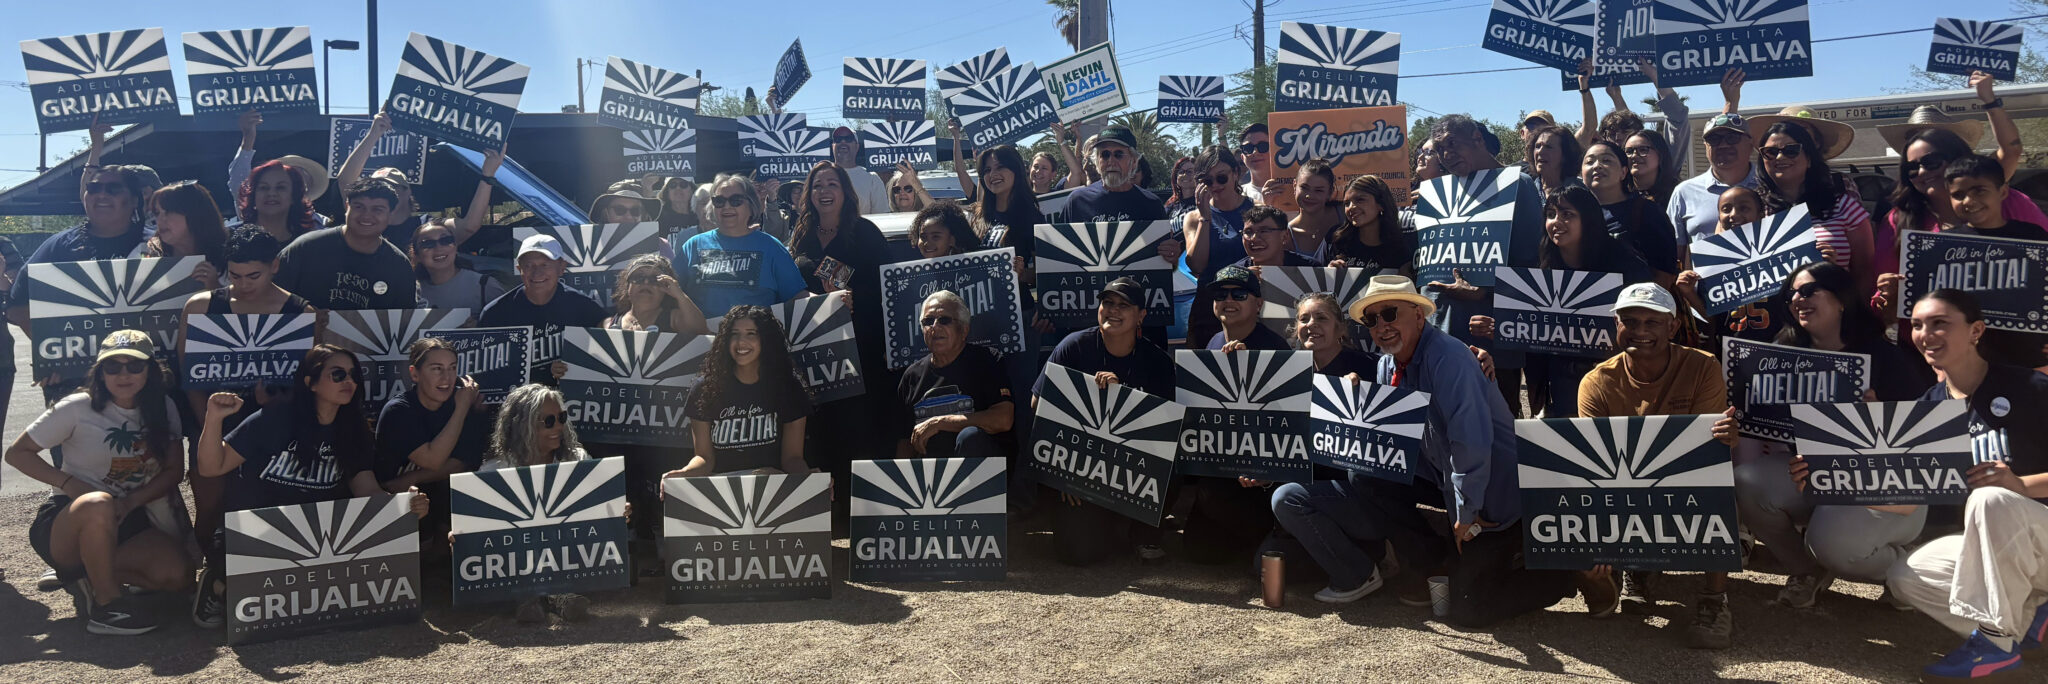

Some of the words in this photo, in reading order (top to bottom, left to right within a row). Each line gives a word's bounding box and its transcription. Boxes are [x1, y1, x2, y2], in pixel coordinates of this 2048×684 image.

[1508, 17, 1577, 42] ADELITA
[1682, 27, 1784, 45] ADELITA
[1490, 24, 1587, 61] GRIJALVA
[1662, 39, 1808, 70] GRIJALVA
[1934, 52, 2012, 71] GRIJALVA
[212, 72, 296, 85] ADELITA
[1063, 60, 1104, 83] KEVIN
[1299, 69, 1378, 84] ADELITA
[58, 76, 150, 94] ADELITA
[196, 83, 316, 107] GRIJALVA
[1066, 71, 1111, 96] DAHL
[1280, 80, 1392, 106] GRIJALVA
[41, 87, 174, 117] GRIJALVA
[414, 84, 494, 115] ADELITA
[619, 95, 679, 113] ADELITA
[846, 96, 923, 110] GRIJALVA
[1160, 106, 1221, 116] GRIJALVA
[392, 93, 503, 142] GRIJALVA
[603, 101, 689, 129] GRIJALVA
[973, 102, 1053, 146] GRIJALVA
[980, 98, 1035, 128] ADELITA
[1846, 108, 1867, 119] FOR
[1277, 121, 1402, 168] Miranda
[628, 160, 692, 172] GRIJALVA
[869, 152, 933, 165] GRIJALVA
[1107, 213, 1117, 221] in
[1422, 226, 1490, 242] ADELITA
[1412, 241, 1504, 269] GRIJALVA
[1945, 247, 1968, 261] All
[1970, 248, 1983, 258] in
[1985, 243, 2005, 263] for
[1722, 251, 1797, 282] ADELITA
[1928, 257, 2028, 293] ¡ADELITA!
[919, 280, 939, 299] All
[941, 280, 953, 290] in
[954, 272, 972, 291] for
[64, 313, 179, 331] ADELITA
[534, 327, 544, 336] in
[545, 322, 559, 338] for
[1517, 313, 1596, 326] ADELITA
[470, 338, 481, 347] in
[481, 334, 496, 350] for
[1499, 321, 1613, 347] GRIJALVA
[209, 352, 289, 362] ADELITA
[1758, 357, 1778, 371] All
[1780, 358, 1792, 369] in
[1794, 355, 1813, 375] for
[585, 386, 684, 401] ADELITA
[1744, 370, 1836, 413] ¡ADELITA!
[720, 405, 736, 419] All
[737, 407, 747, 416] in
[748, 403, 764, 419] for
[1198, 413, 1289, 428] ADELITA
[1180, 428, 1309, 460] GRIJALVA
[1325, 424, 1395, 446] ADELITA
[1056, 429, 1146, 468] ADELITA
[1313, 432, 1408, 470] GRIJALVA
[1033, 439, 1160, 504] GRIJALVA
[1831, 456, 1940, 468] ADELITA
[1810, 468, 1967, 491] GRIJALVA
[1557, 494, 1699, 507] ADELITA
[878, 519, 981, 532] ADELITA
[1530, 514, 1734, 544] GRIJALVA
[484, 526, 598, 549] ADELITA
[695, 538, 804, 552] ADELITA
[855, 535, 1003, 561] GRIJALVA
[459, 541, 624, 581] GRIJALVA
[1661, 547, 1736, 555] CONGRESS
[263, 562, 390, 589] ADELITA
[671, 554, 829, 582] GRIJALVA
[235, 577, 417, 623] GRIJALVA
